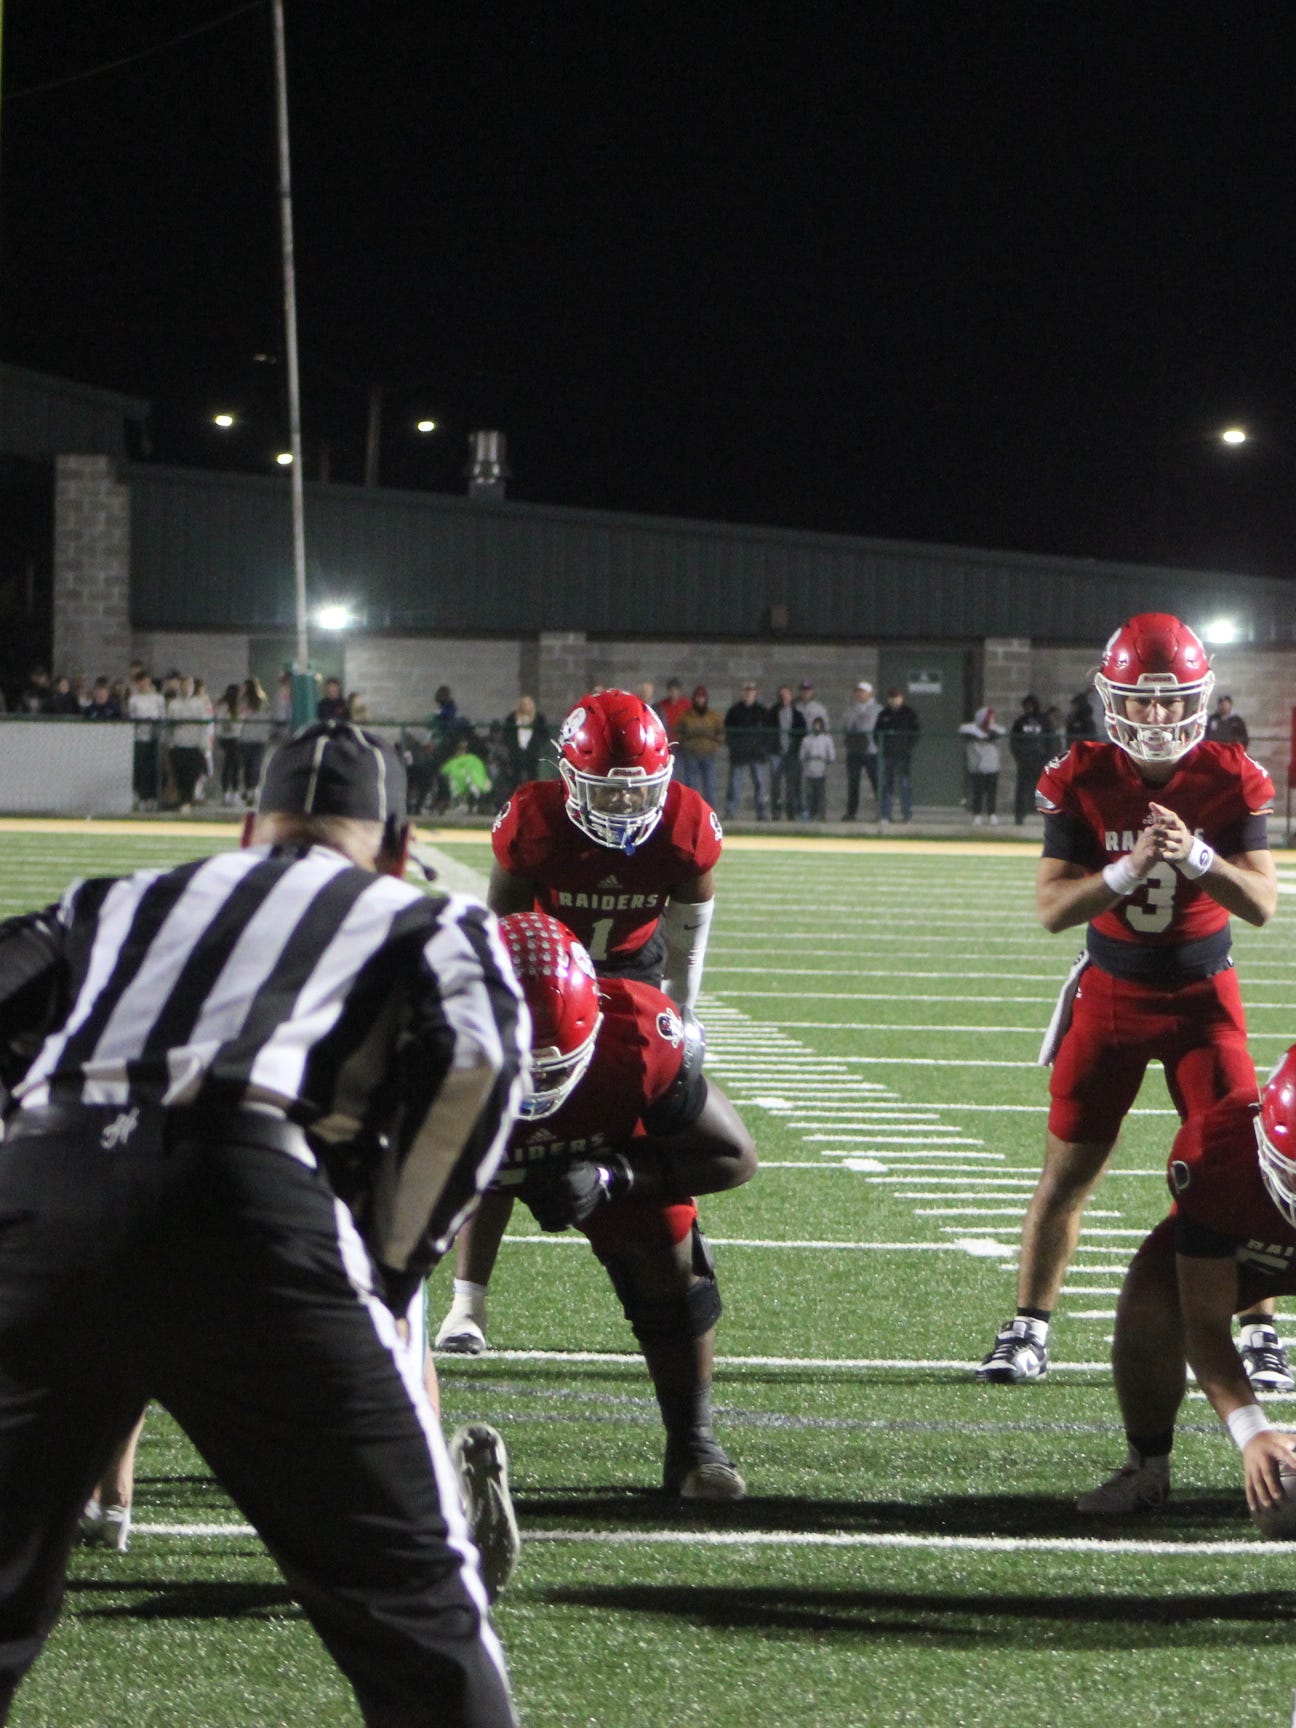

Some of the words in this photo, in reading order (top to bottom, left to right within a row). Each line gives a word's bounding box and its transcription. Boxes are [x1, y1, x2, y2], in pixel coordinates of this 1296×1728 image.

[559, 892, 659, 910] RAIDERS
[1126, 860, 1177, 933] 3
[589, 918, 614, 960] 1
